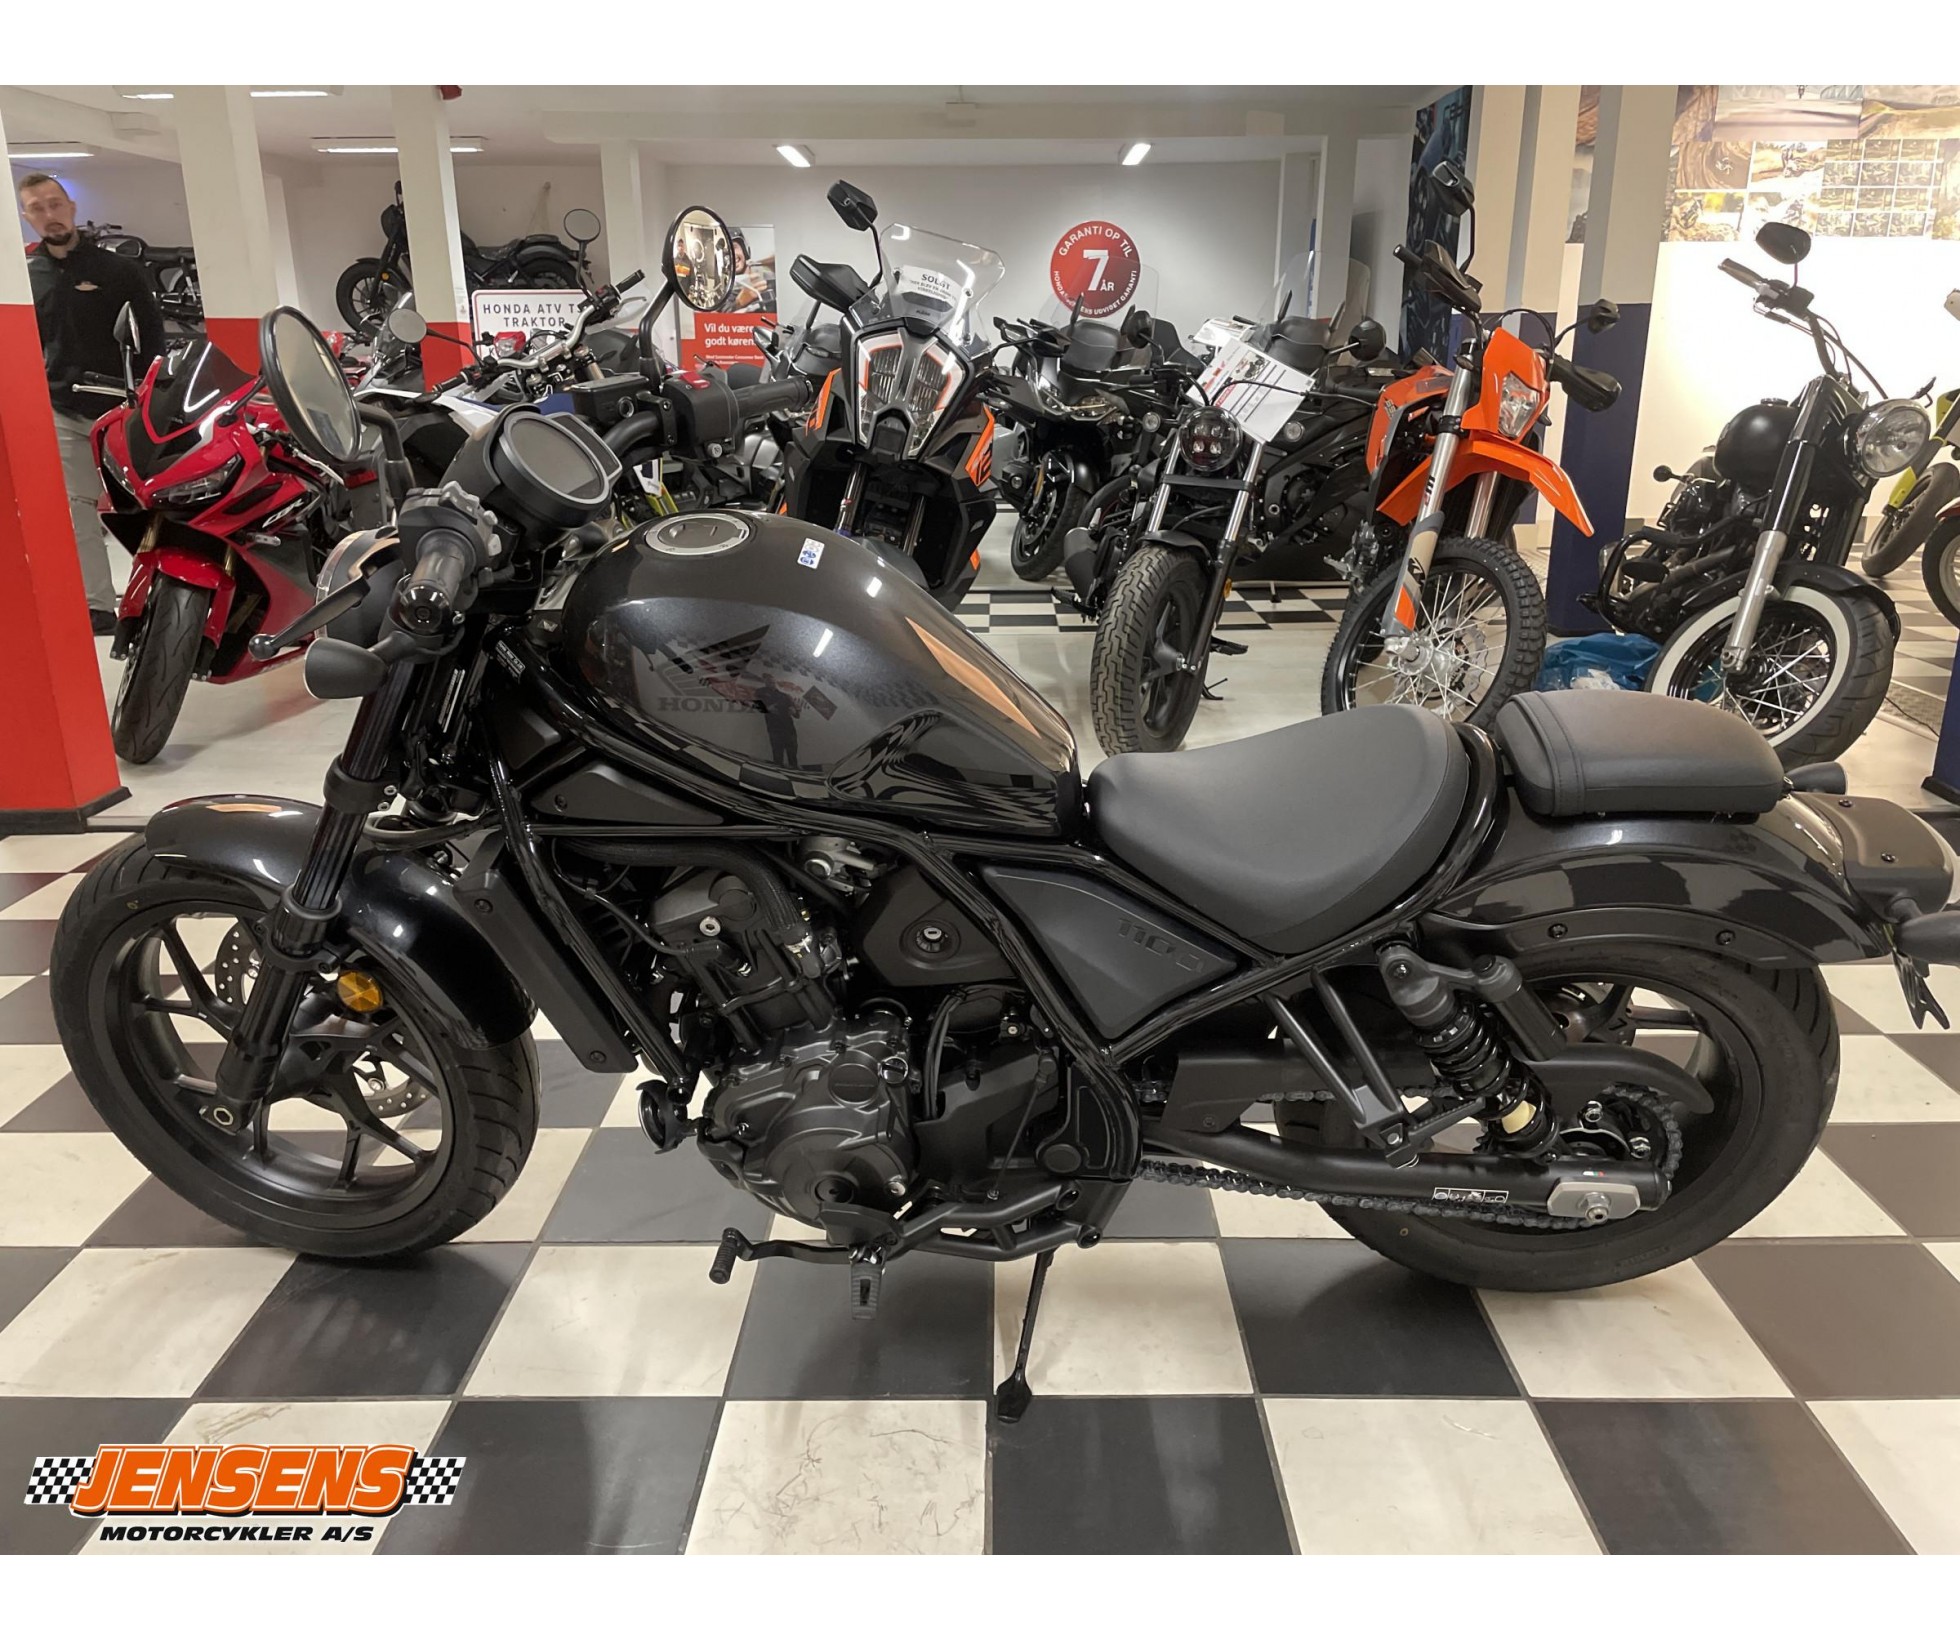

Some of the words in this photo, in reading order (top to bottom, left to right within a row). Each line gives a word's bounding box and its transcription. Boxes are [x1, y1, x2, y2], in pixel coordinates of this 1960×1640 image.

[1059, 226, 1102, 256] GARANTI
[1104, 228, 1121, 240] OP
[1120, 239, 1133, 258] TIL
[1083, 249, 1109, 291] 7
[1100, 279, 1115, 291] ÅR
[1093, 299, 1120, 315] UDVIDET
[1120, 270, 1137, 301] GARANTI
[483, 303, 531, 314] HONDA
[537, 303, 561, 314] ATV
[504, 317, 566, 327] TRAKTOR
[704, 323, 716, 332] Vil
[718, 323, 730, 333] du
[705, 337, 727, 348] godt
[728, 336, 757, 346] køren
